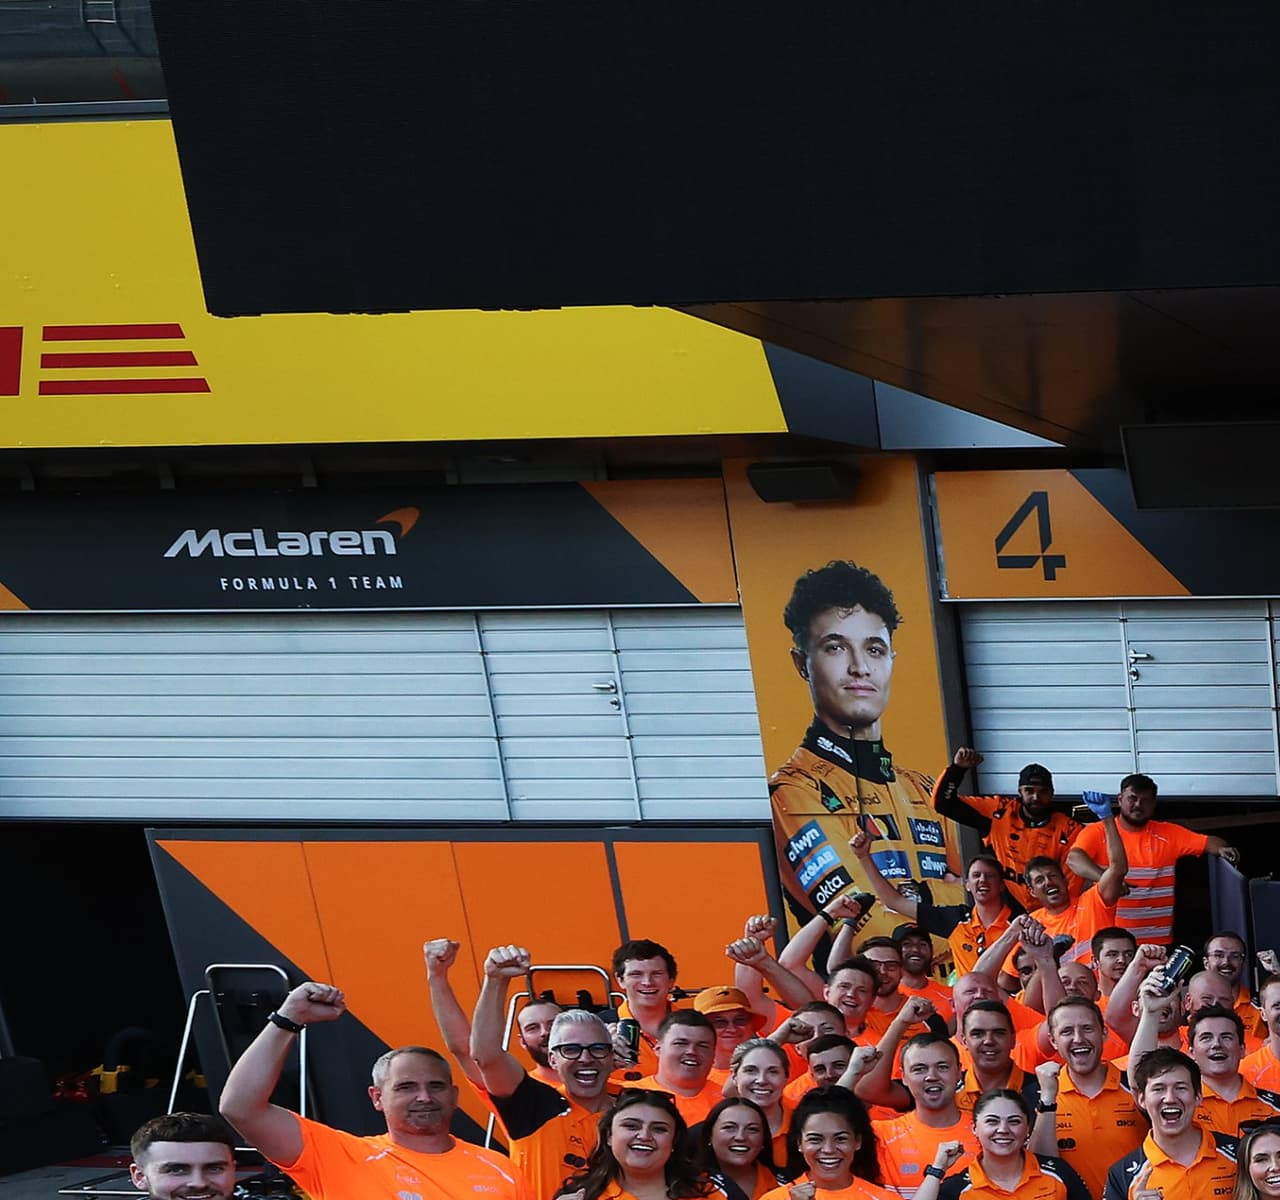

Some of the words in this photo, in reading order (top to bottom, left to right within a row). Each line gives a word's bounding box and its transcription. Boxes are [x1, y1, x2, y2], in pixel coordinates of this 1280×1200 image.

[164, 528, 396, 558] McLaren
[995, 491, 1066, 580] 4
[220, 576, 318, 591] FORMULA
[329, 577, 338, 591] 1
[350, 576, 404, 591] TEAM
[815, 875, 845, 906] okta
